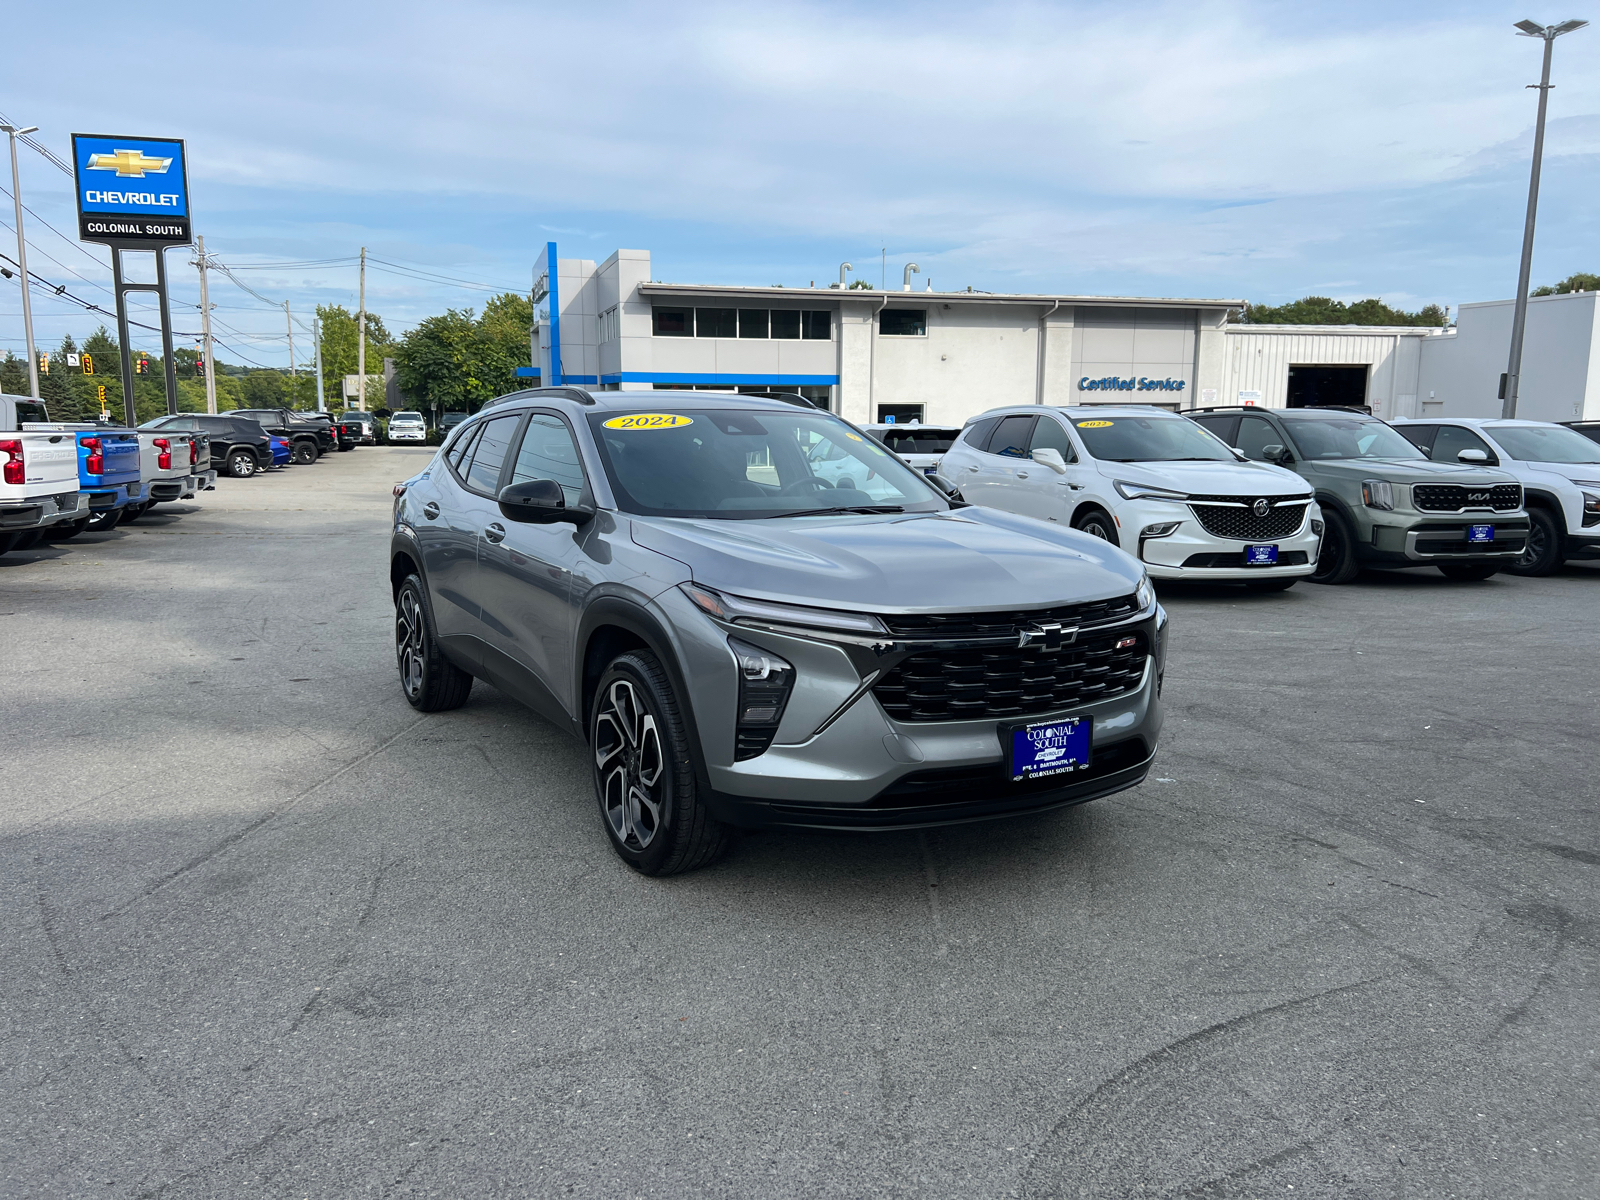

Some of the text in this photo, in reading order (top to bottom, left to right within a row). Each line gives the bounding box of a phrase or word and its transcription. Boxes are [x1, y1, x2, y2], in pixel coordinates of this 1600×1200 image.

[86, 190, 179, 206] CHEVROLET
[87, 223, 182, 235] COLONIAL SOUTH
[1079, 376, 1186, 391] Certified Service
[621, 416, 677, 428] 2024
[1027, 725, 1074, 741] COLONIAL
[1034, 736, 1067, 750] SOUTH
[1028, 770, 1055, 778] COLONIAL
